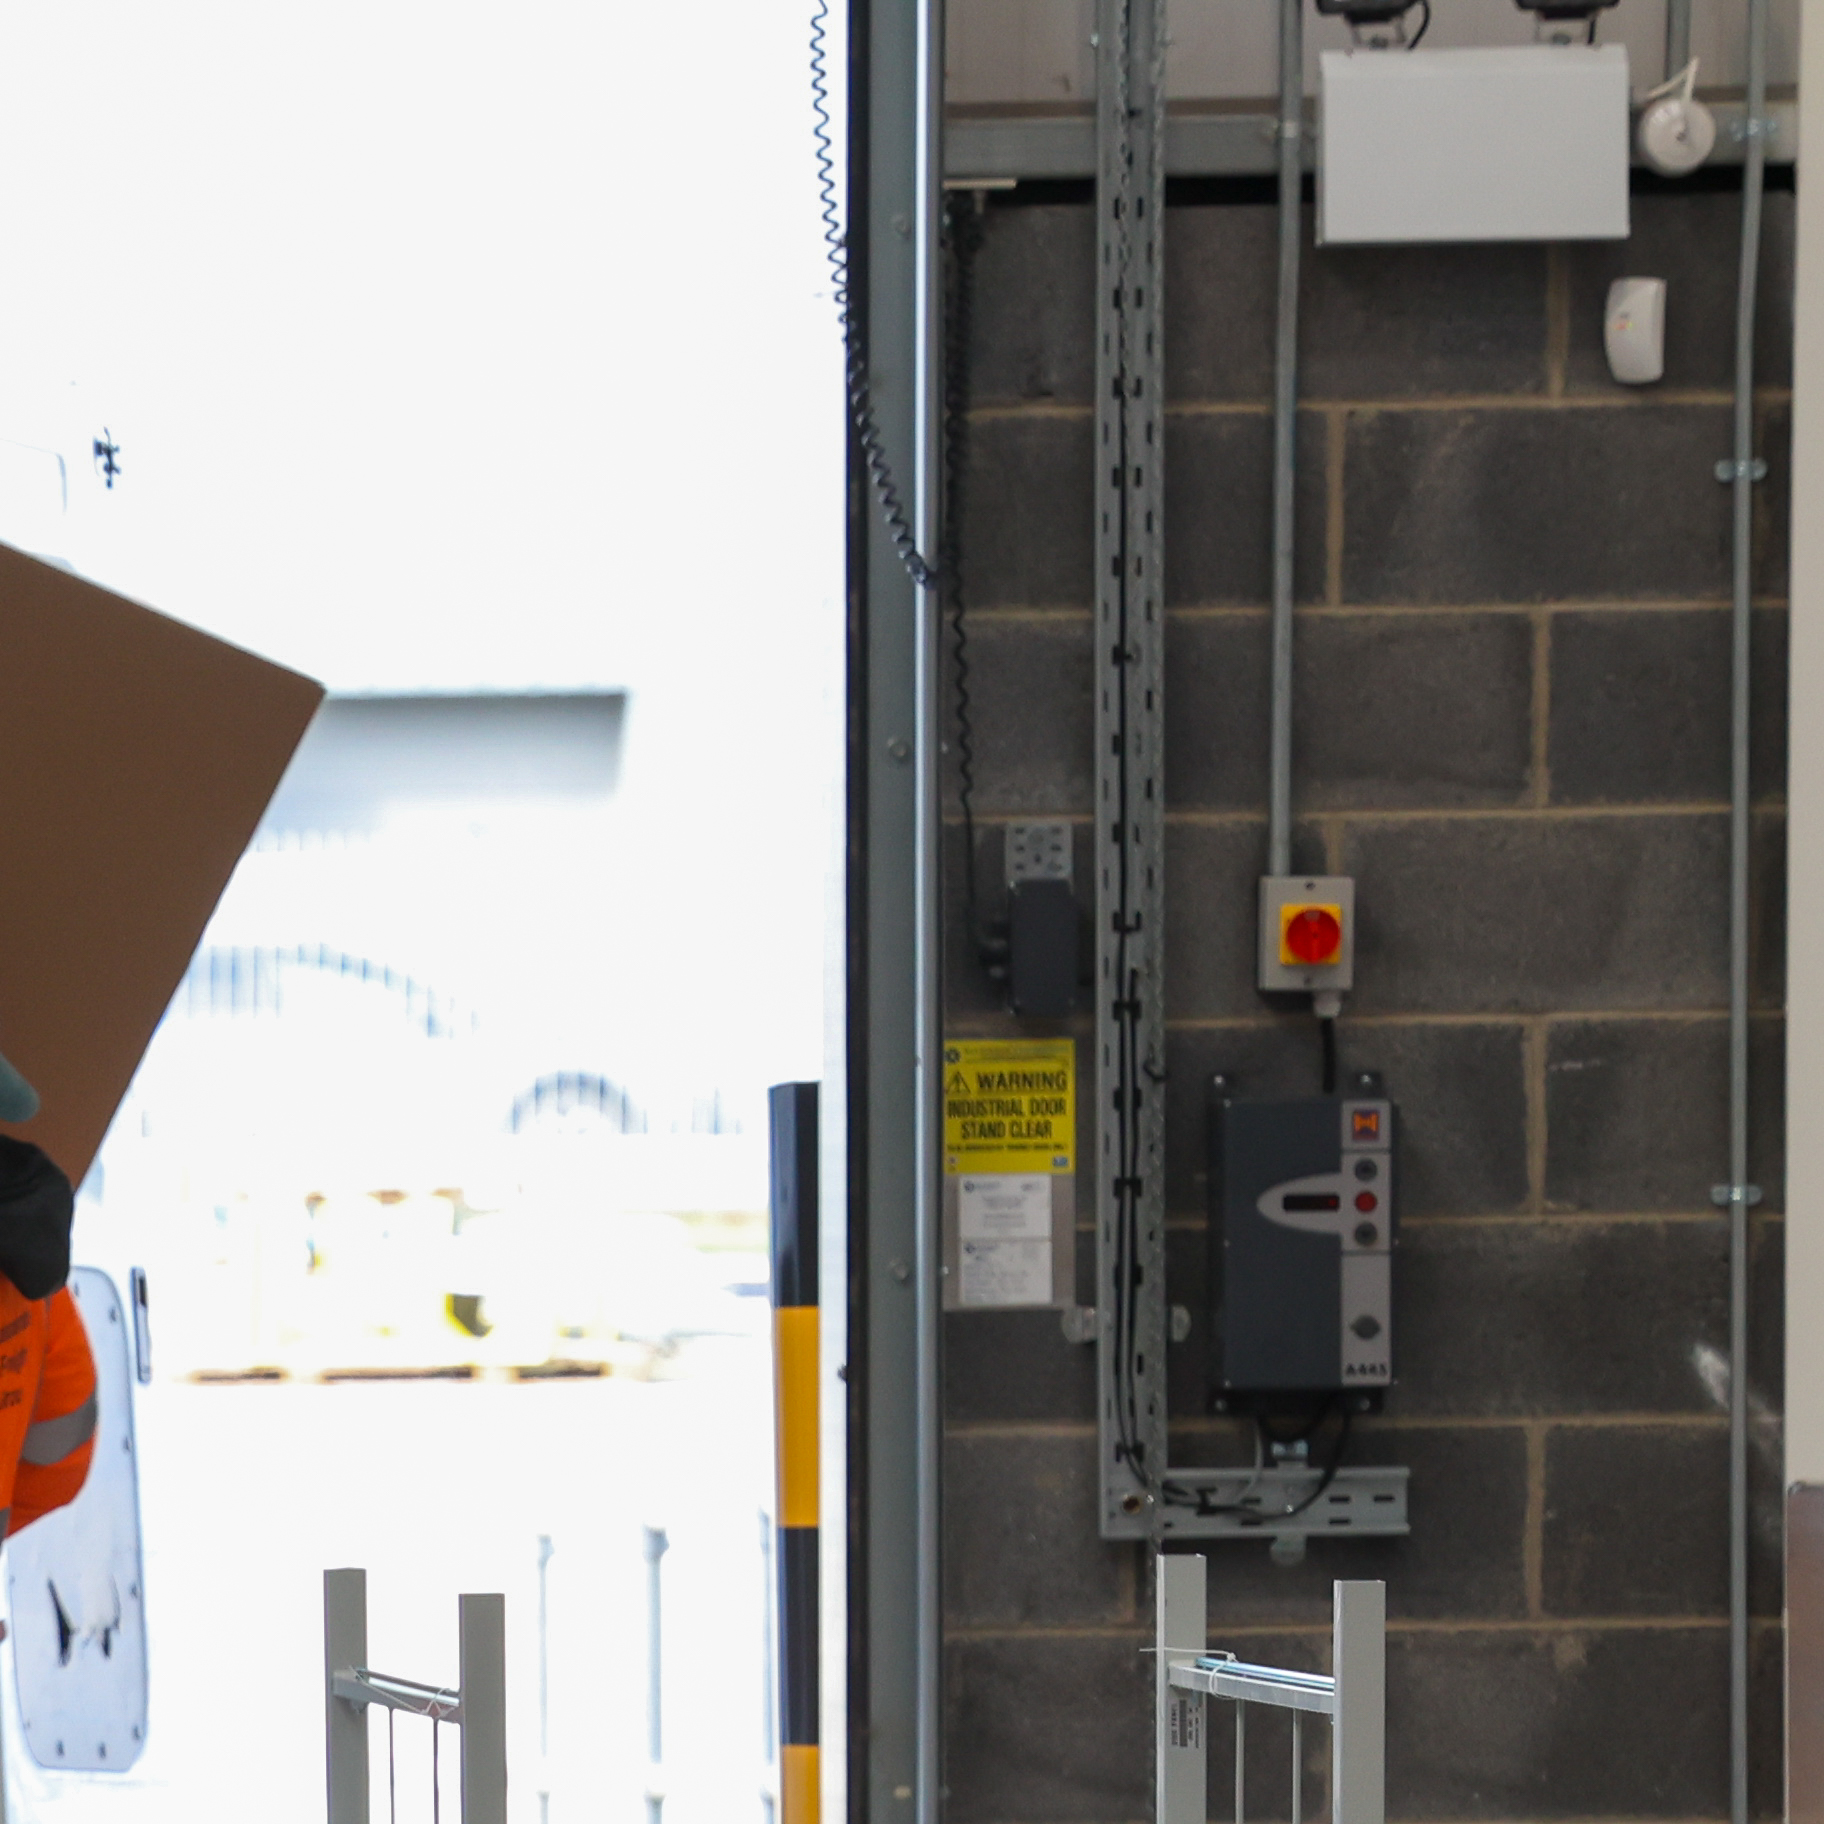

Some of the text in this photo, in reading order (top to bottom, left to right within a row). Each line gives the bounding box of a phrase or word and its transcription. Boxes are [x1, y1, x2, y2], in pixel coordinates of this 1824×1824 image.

[976, 1070, 1067, 1091] WARNING
[947, 1097, 1066, 1117] INDUSTRIAL DOOR
[961, 1120, 1053, 1140] STAND CLEAR
